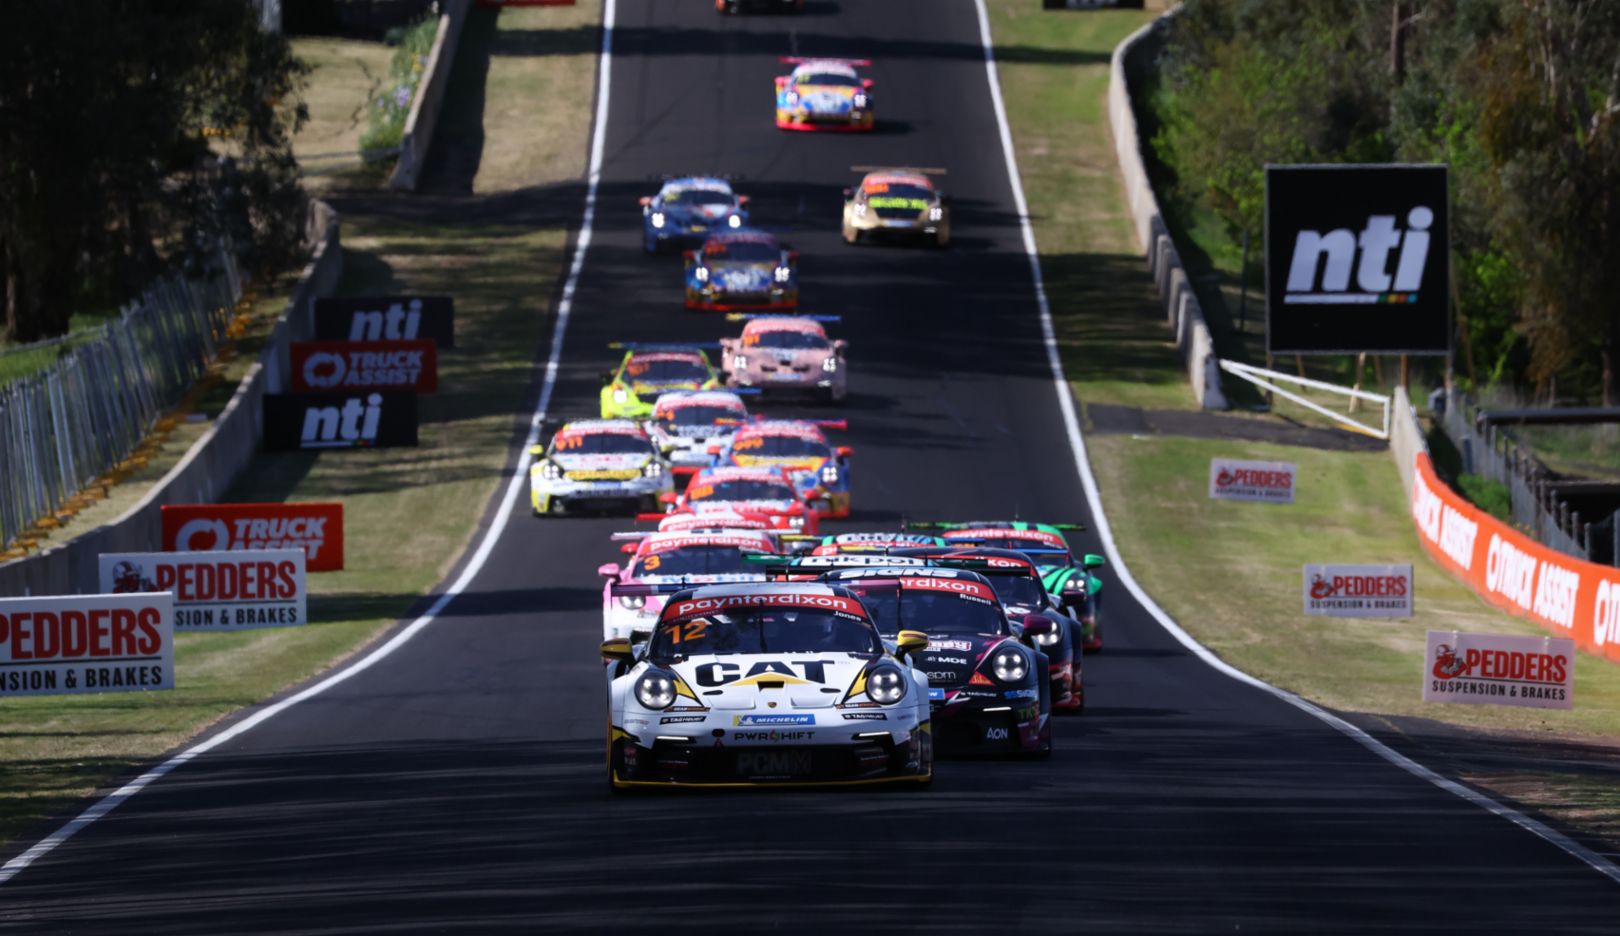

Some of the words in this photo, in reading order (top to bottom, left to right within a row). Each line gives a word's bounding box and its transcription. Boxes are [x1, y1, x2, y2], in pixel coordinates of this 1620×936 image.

[1286, 206, 1434, 291] nti
[349, 299, 422, 341] nti
[349, 351, 424, 368] TRUCK
[344, 369, 420, 385] ASSIST
[301, 392, 383, 440] nti
[1235, 469, 1291, 489] PEDDERS
[234, 517, 327, 539] TRUCK
[650, 536, 763, 550] paynterdixon
[643, 555, 661, 571] 3
[156, 560, 297, 601] PEDDERS
[1333, 576, 1407, 596] PEDDERS
[679, 594, 848, 615] paynterdixon
[960, 593, 991, 606] Russell
[220, 609, 230, 625] &
[236, 607, 297, 625] BRAKES
[833, 610, 862, 621] Jones
[664, 620, 707, 644] 12
[695, 661, 835, 687] CAT
[1465, 648, 1568, 682] PEDDERS
[65, 669, 77, 688] &
[85, 665, 162, 688] BRAKES
[1433, 680, 1506, 697] SUSPENSION
[1510, 687, 1517, 697] &
[1521, 686, 1566, 701] BRAKES
